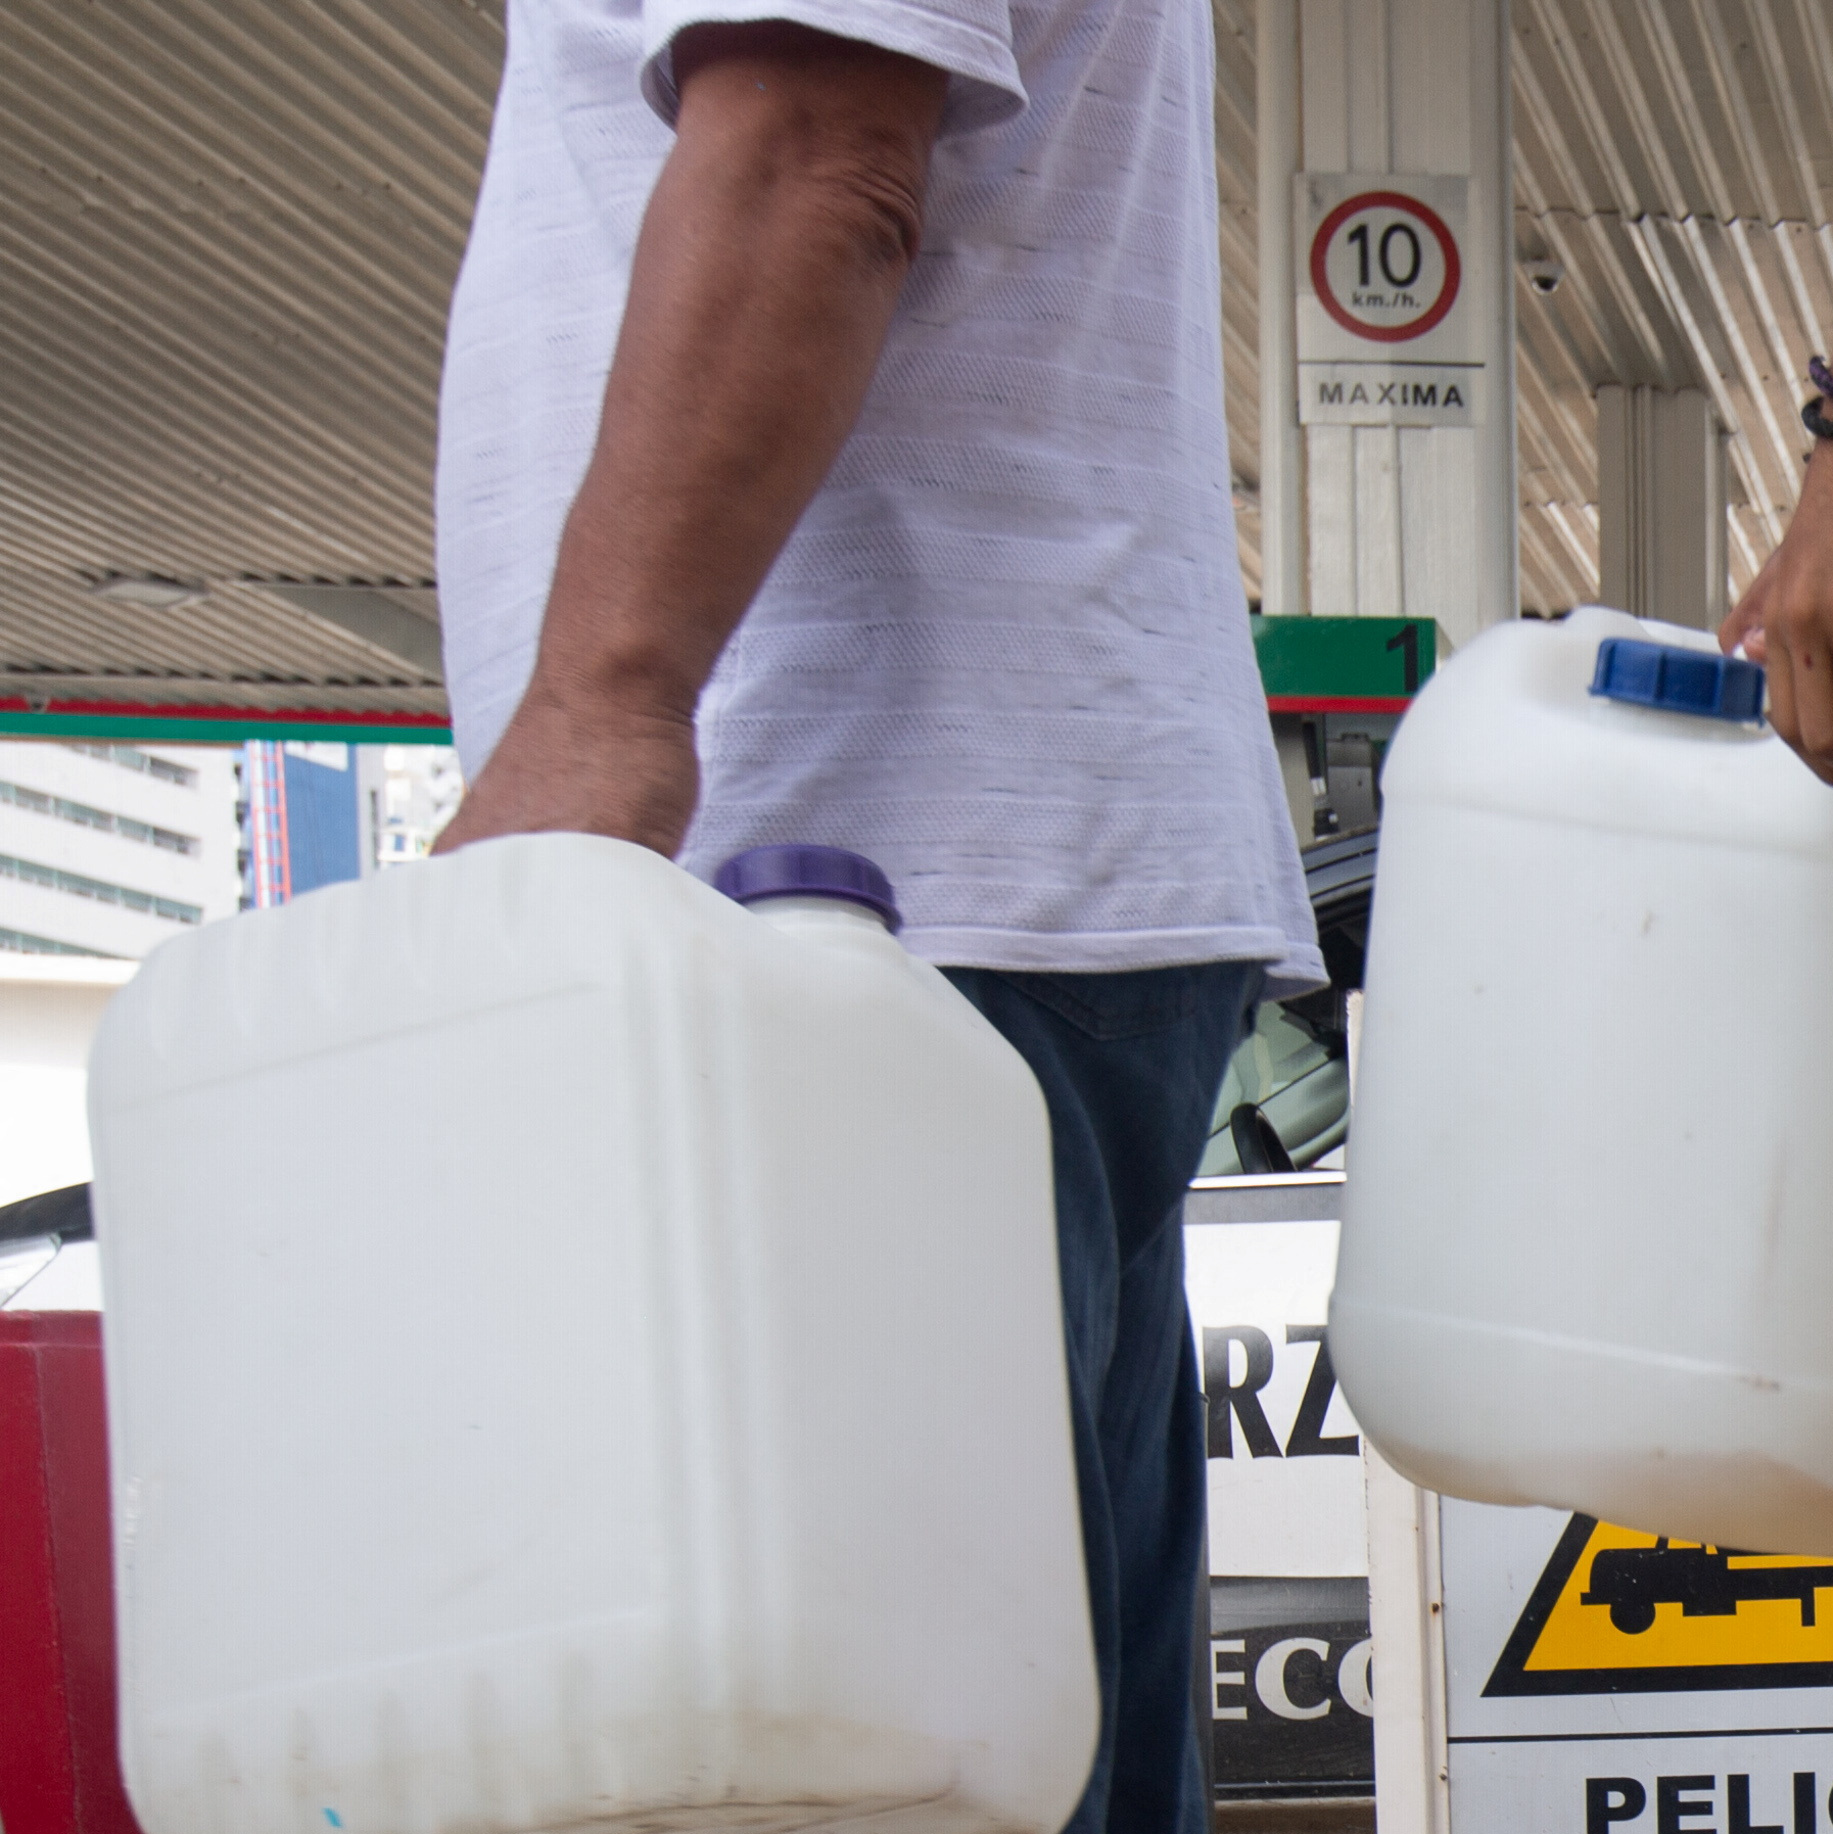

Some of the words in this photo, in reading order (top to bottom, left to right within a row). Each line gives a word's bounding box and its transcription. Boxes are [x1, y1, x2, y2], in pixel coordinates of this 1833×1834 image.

[1347, 222, 1421, 288] 10
[1319, 382, 1465, 407] MAXIMA
[1386, 624, 1418, 693] 1
[1203, 1325, 1361, 1459] RZ
